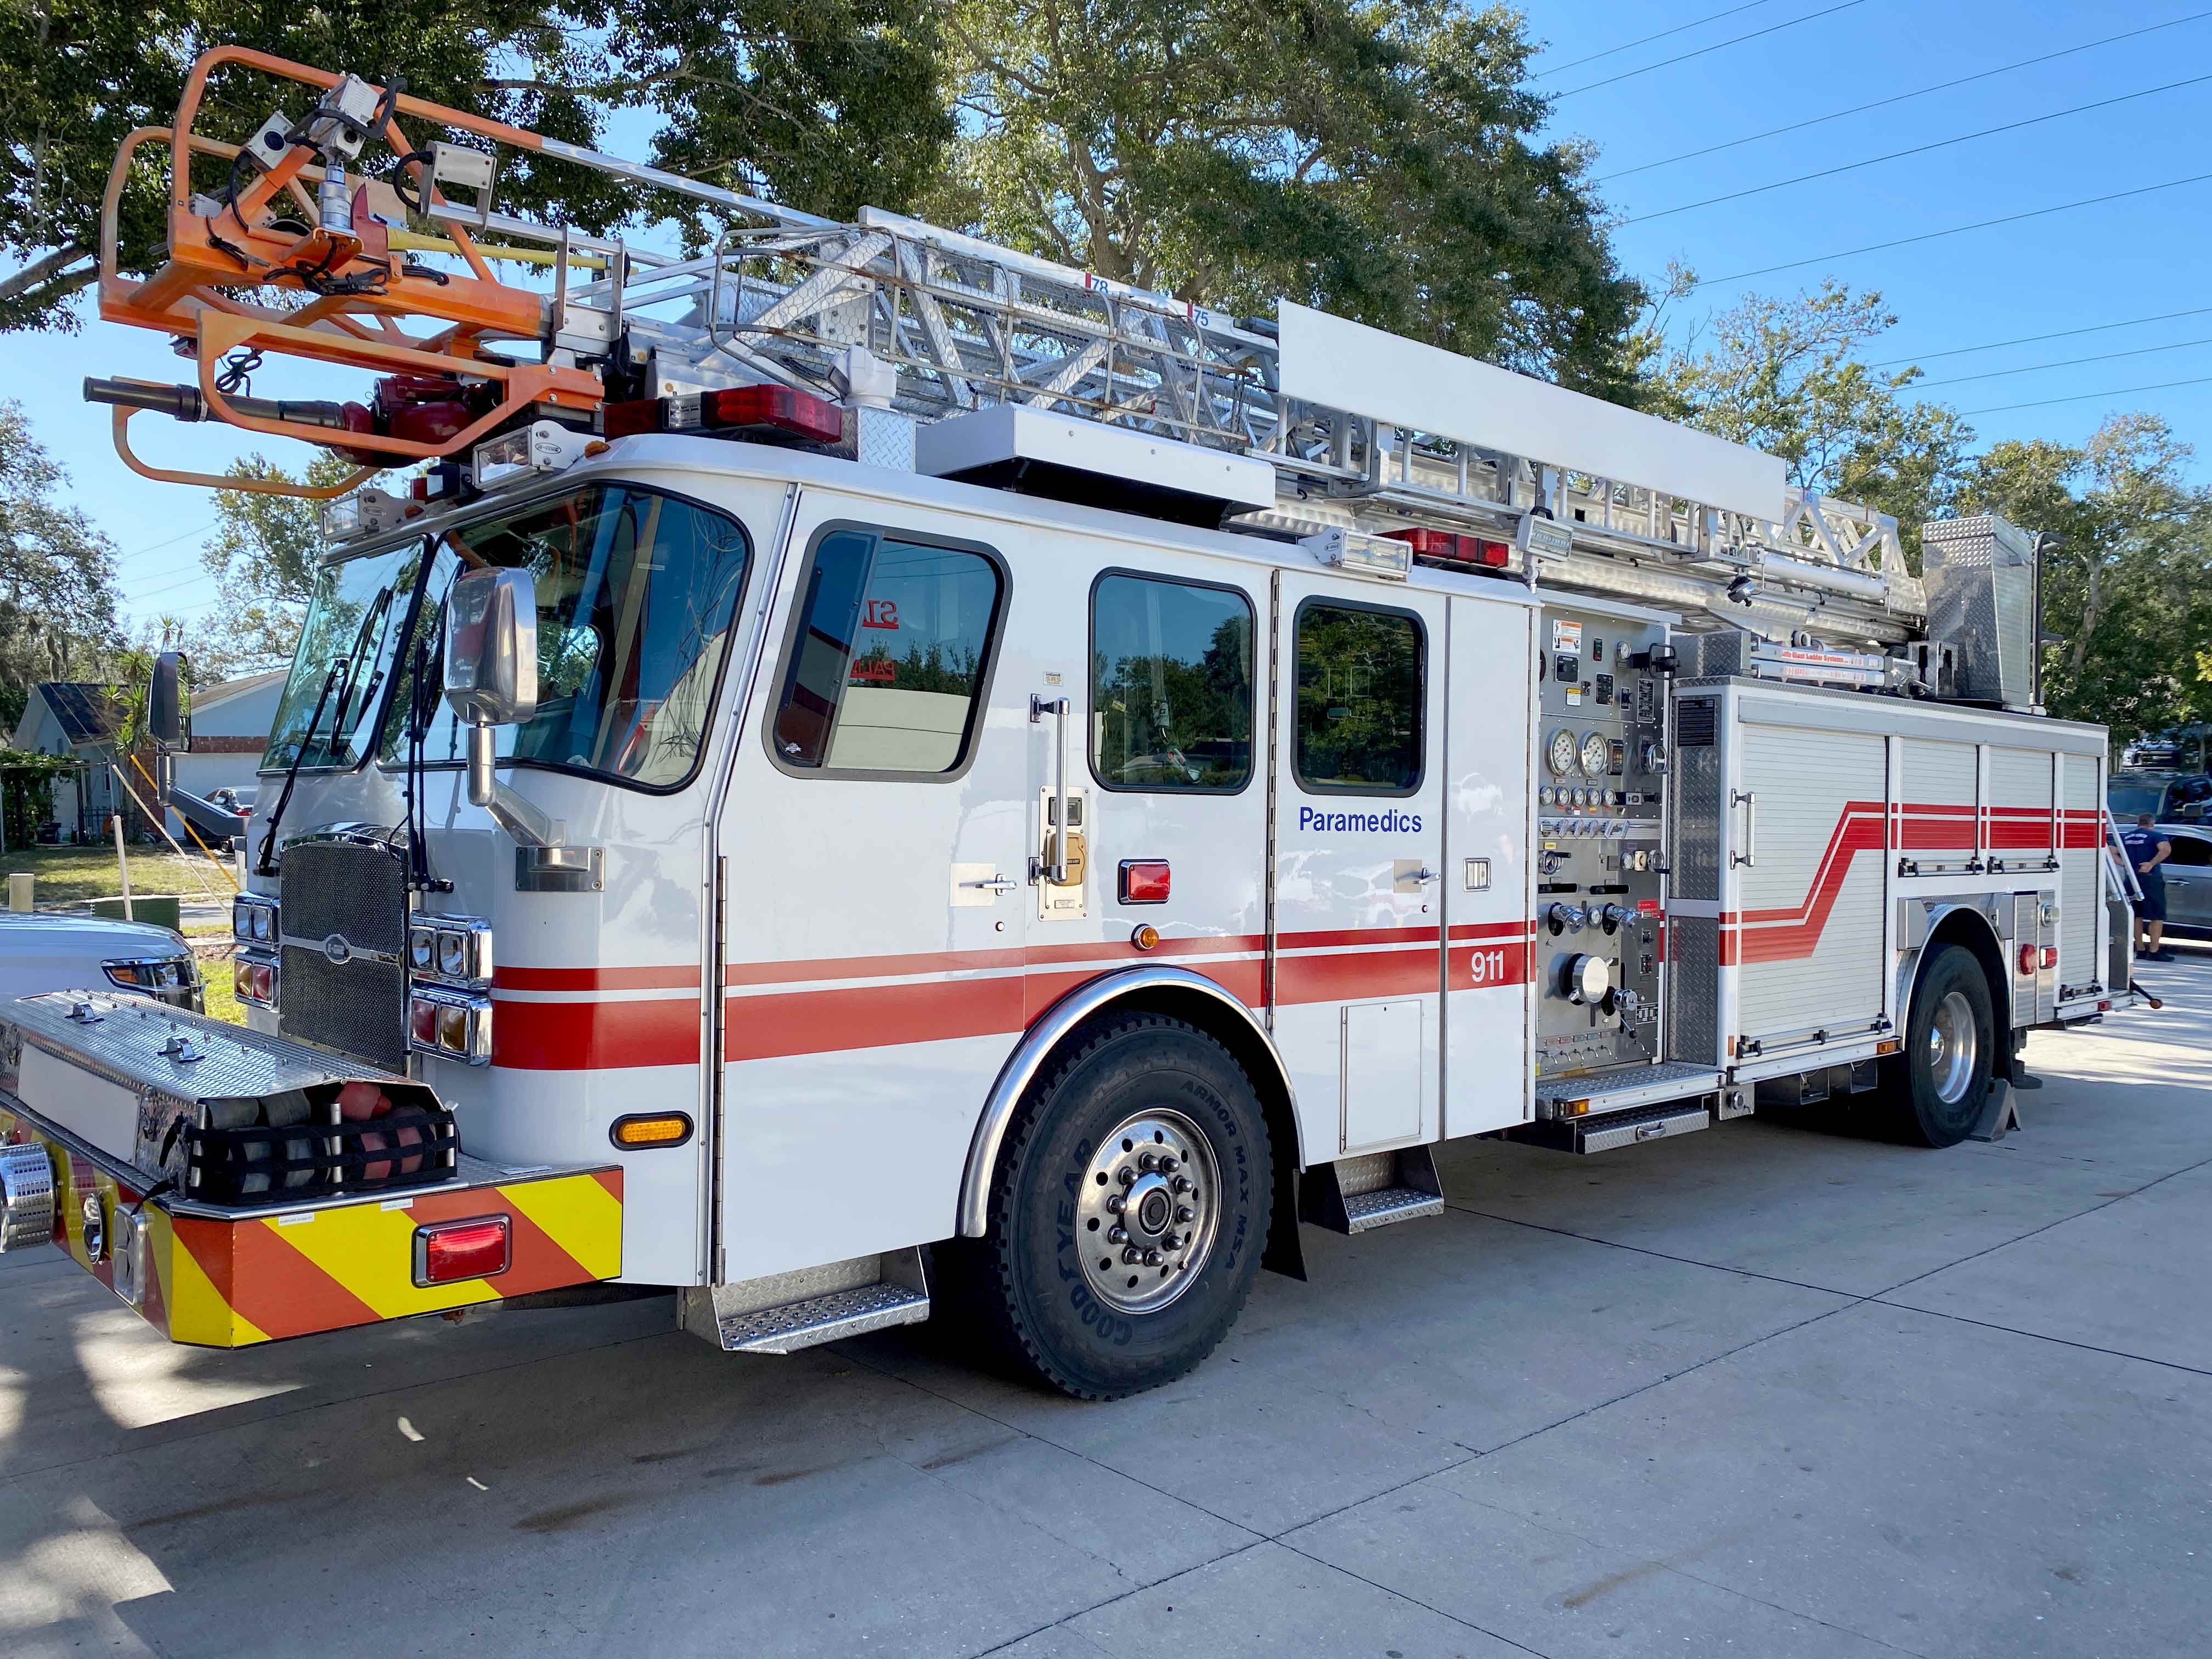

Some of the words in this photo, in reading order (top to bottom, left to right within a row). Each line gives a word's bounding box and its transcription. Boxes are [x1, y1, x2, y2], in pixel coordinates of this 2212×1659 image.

[1092, 278, 1108, 294] 78
[1194, 309, 1209, 326] 75
[1300, 806, 1422, 833] Paramedics
[1471, 950, 1504, 983] 911
[1181, 1079, 1236, 1138] ARMOR
[1234, 1146, 1250, 1206] MAX
[1224, 1215, 1247, 1270] MSA
